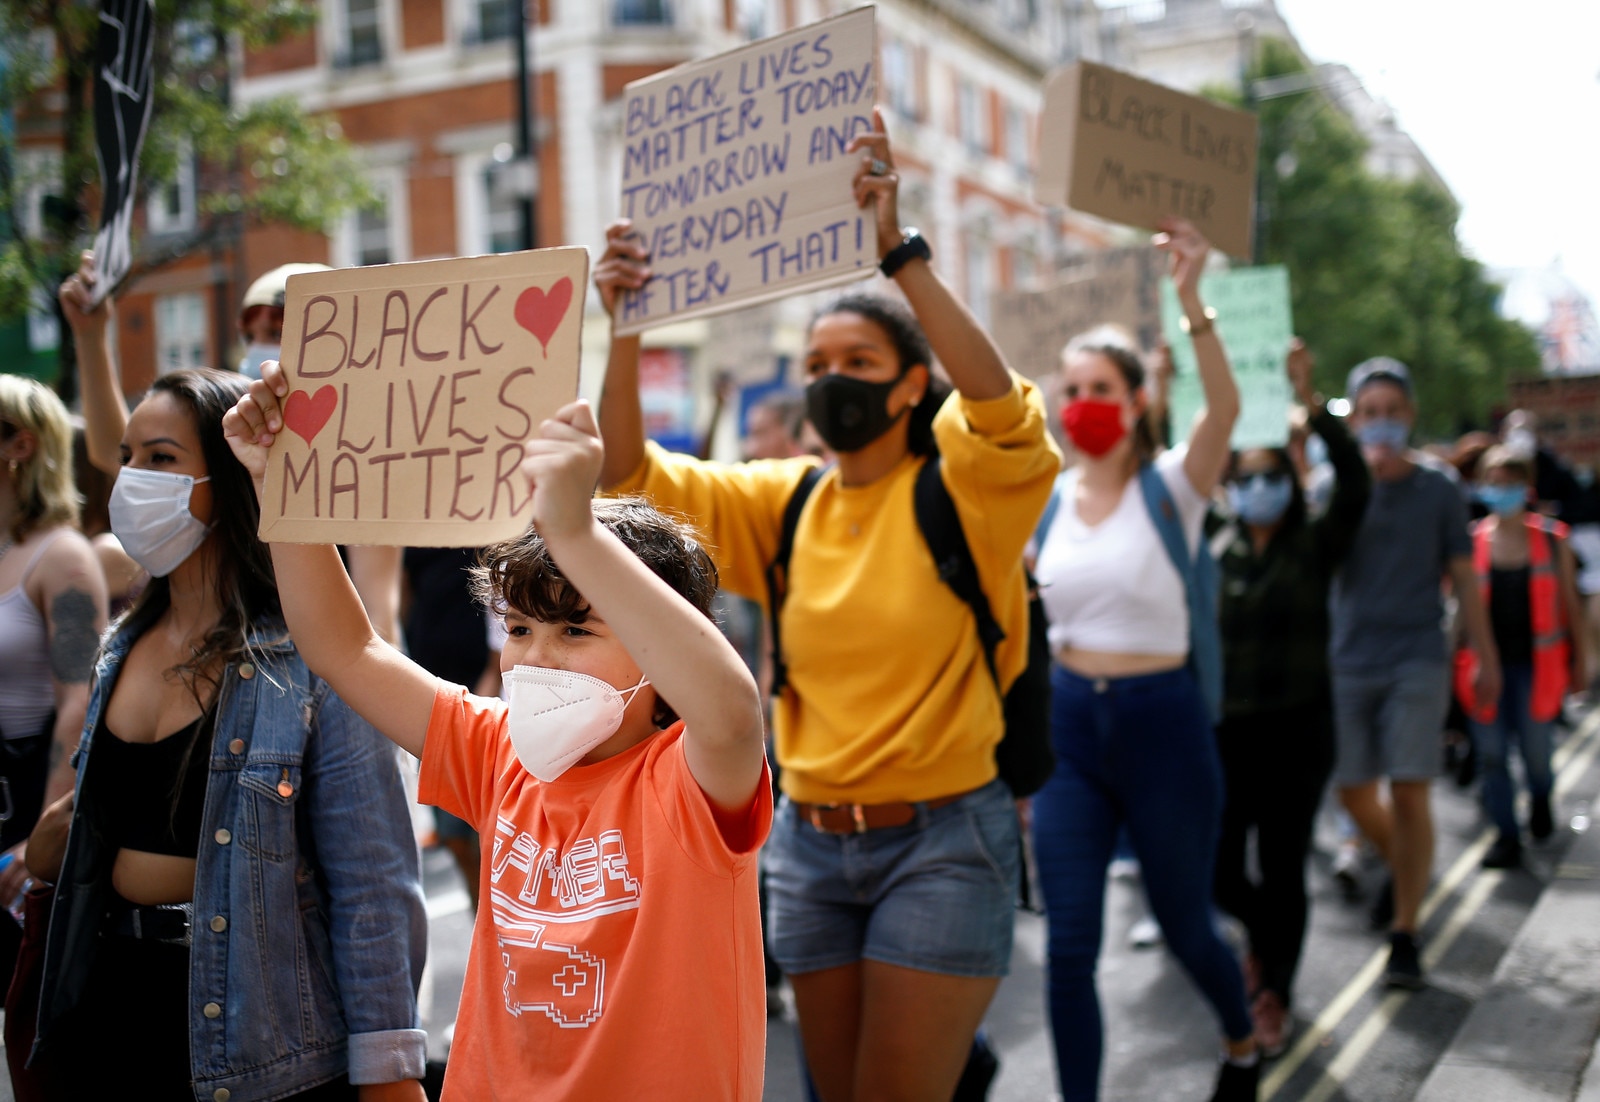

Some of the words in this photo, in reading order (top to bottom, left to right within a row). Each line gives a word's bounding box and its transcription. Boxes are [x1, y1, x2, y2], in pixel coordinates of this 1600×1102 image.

[626, 70, 726, 137] BLACK
[738, 33, 833, 96] LIVES
[1080, 71, 1173, 147] BLACK
[1180, 109, 1248, 175] LIVES
[623, 98, 764, 181] MATTER
[623, 132, 791, 219] TOMORROW
[622, 191, 788, 265] VERYDAY
[1094, 156, 1216, 220] MATTER
[749, 216, 864, 285] THAT!
[297, 284, 504, 378] BLACK
[337, 367, 535, 455] LIVES
[280, 443, 532, 521] MATTER
[491, 814, 642, 909] AMER
